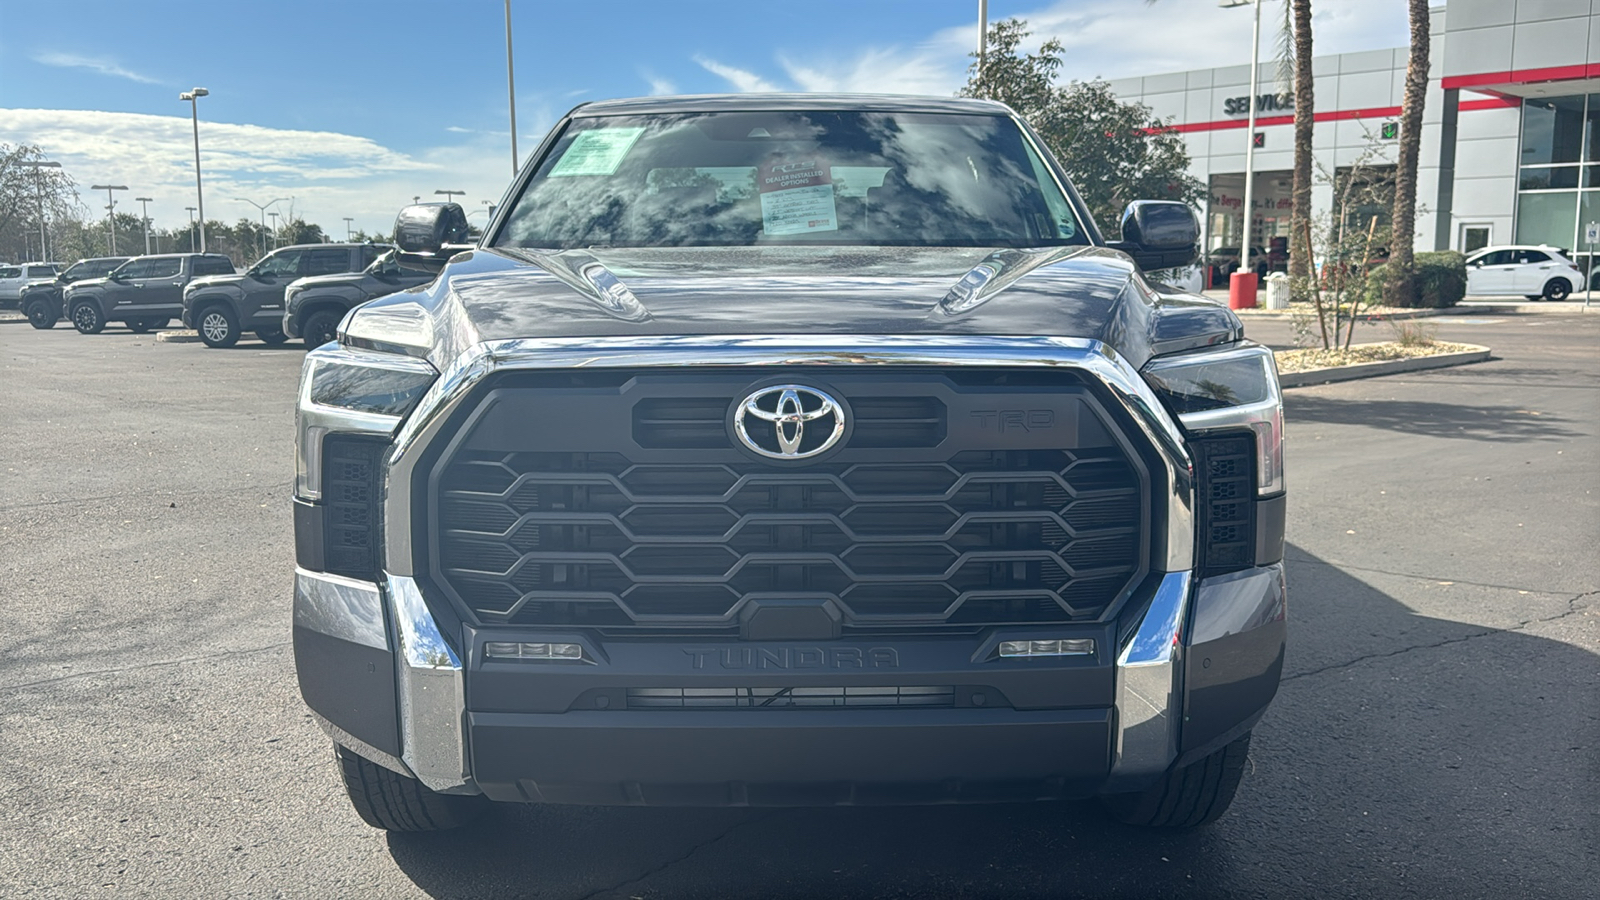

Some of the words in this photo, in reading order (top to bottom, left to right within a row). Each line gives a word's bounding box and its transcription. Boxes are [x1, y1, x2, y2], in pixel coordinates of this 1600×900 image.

[765, 175, 789, 184] DEALER
[790, 170, 824, 180] INSTALLED
[780, 178, 809, 187] OPTIONS
[970, 409, 1055, 433] TRD
[682, 646, 900, 670] TUNDRA
